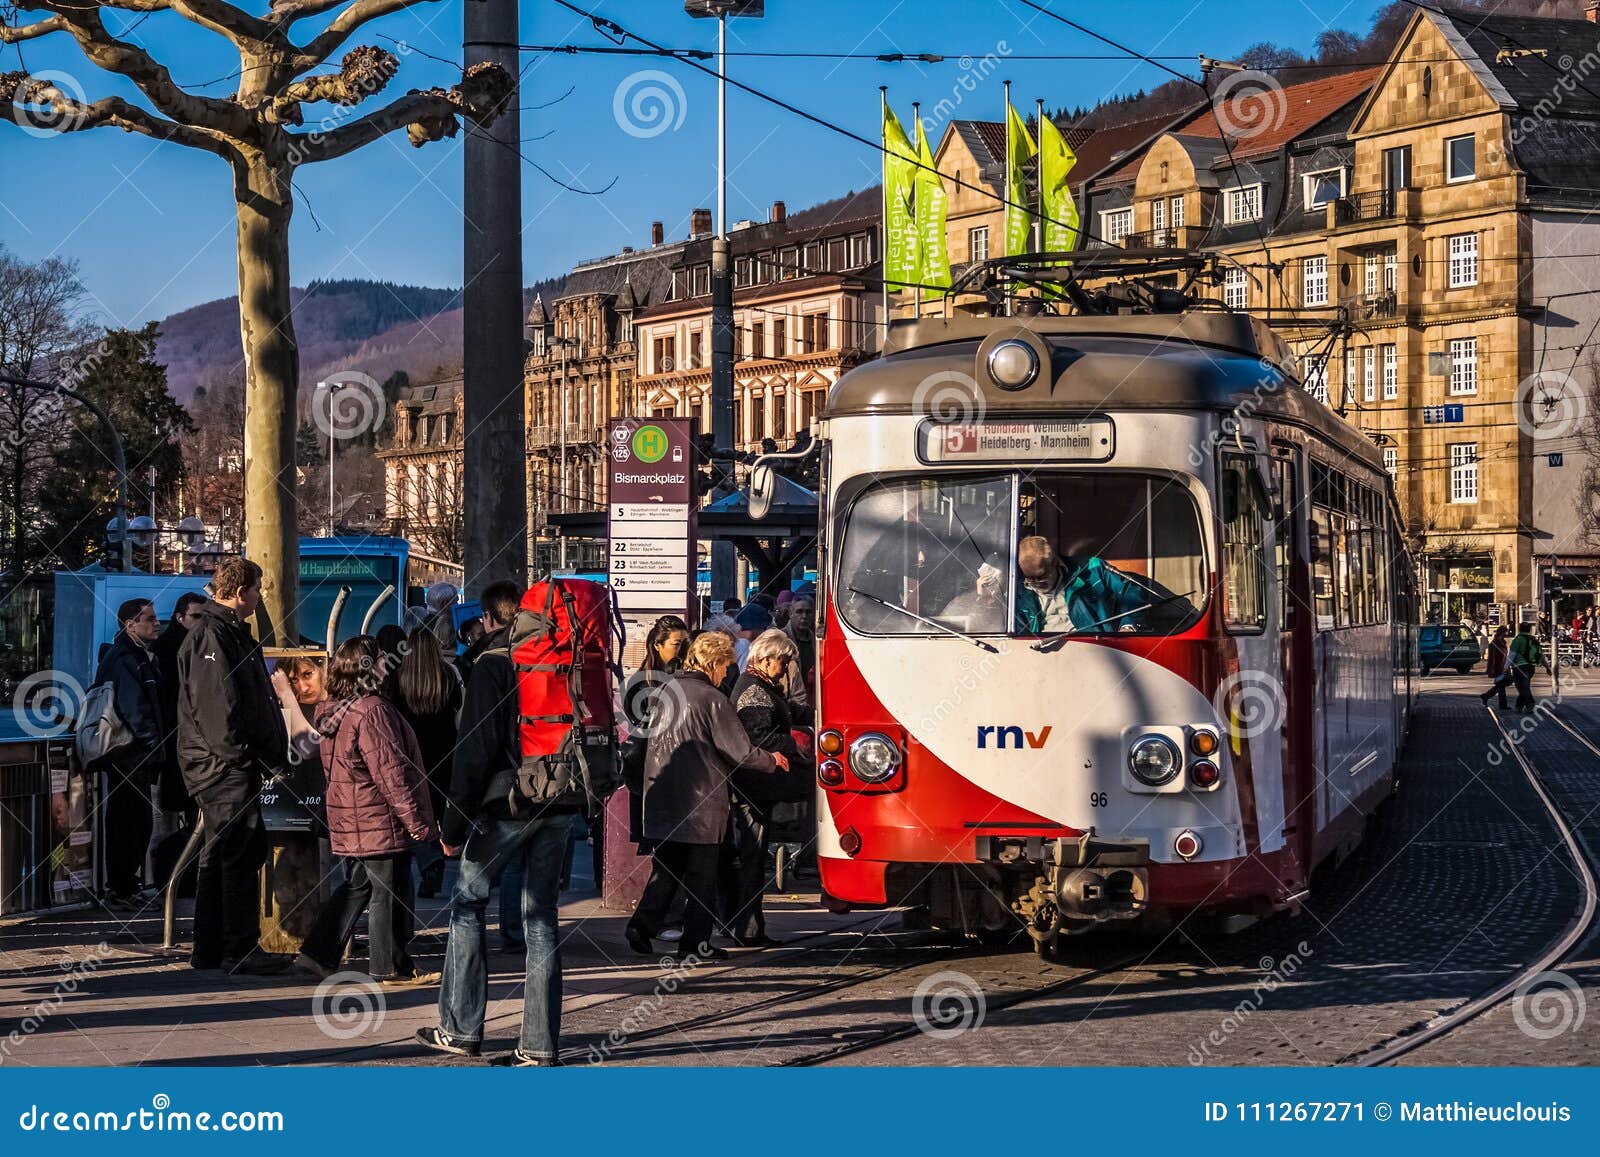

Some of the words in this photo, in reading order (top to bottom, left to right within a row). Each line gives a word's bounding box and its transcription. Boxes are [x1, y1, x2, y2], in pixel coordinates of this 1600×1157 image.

[1449, 407, 1459, 420] T
[641, 434, 659, 454] H
[980, 436, 1031, 451] Heidelberg
[1040, 434, 1090, 448] Mannheim
[614, 449, 629, 459] 125
[1550, 455, 1561, 465] W
[614, 472, 686, 485] Bismarckplatz
[618, 508, 625, 517] 5
[614, 542, 627, 552] 22
[310, 562, 374, 577] Hauptbahnhof
[614, 560, 627, 570] 23
[614, 578, 627, 588] 26
[977, 725, 1053, 749] rnv
[1090, 792, 1109, 807] 96
